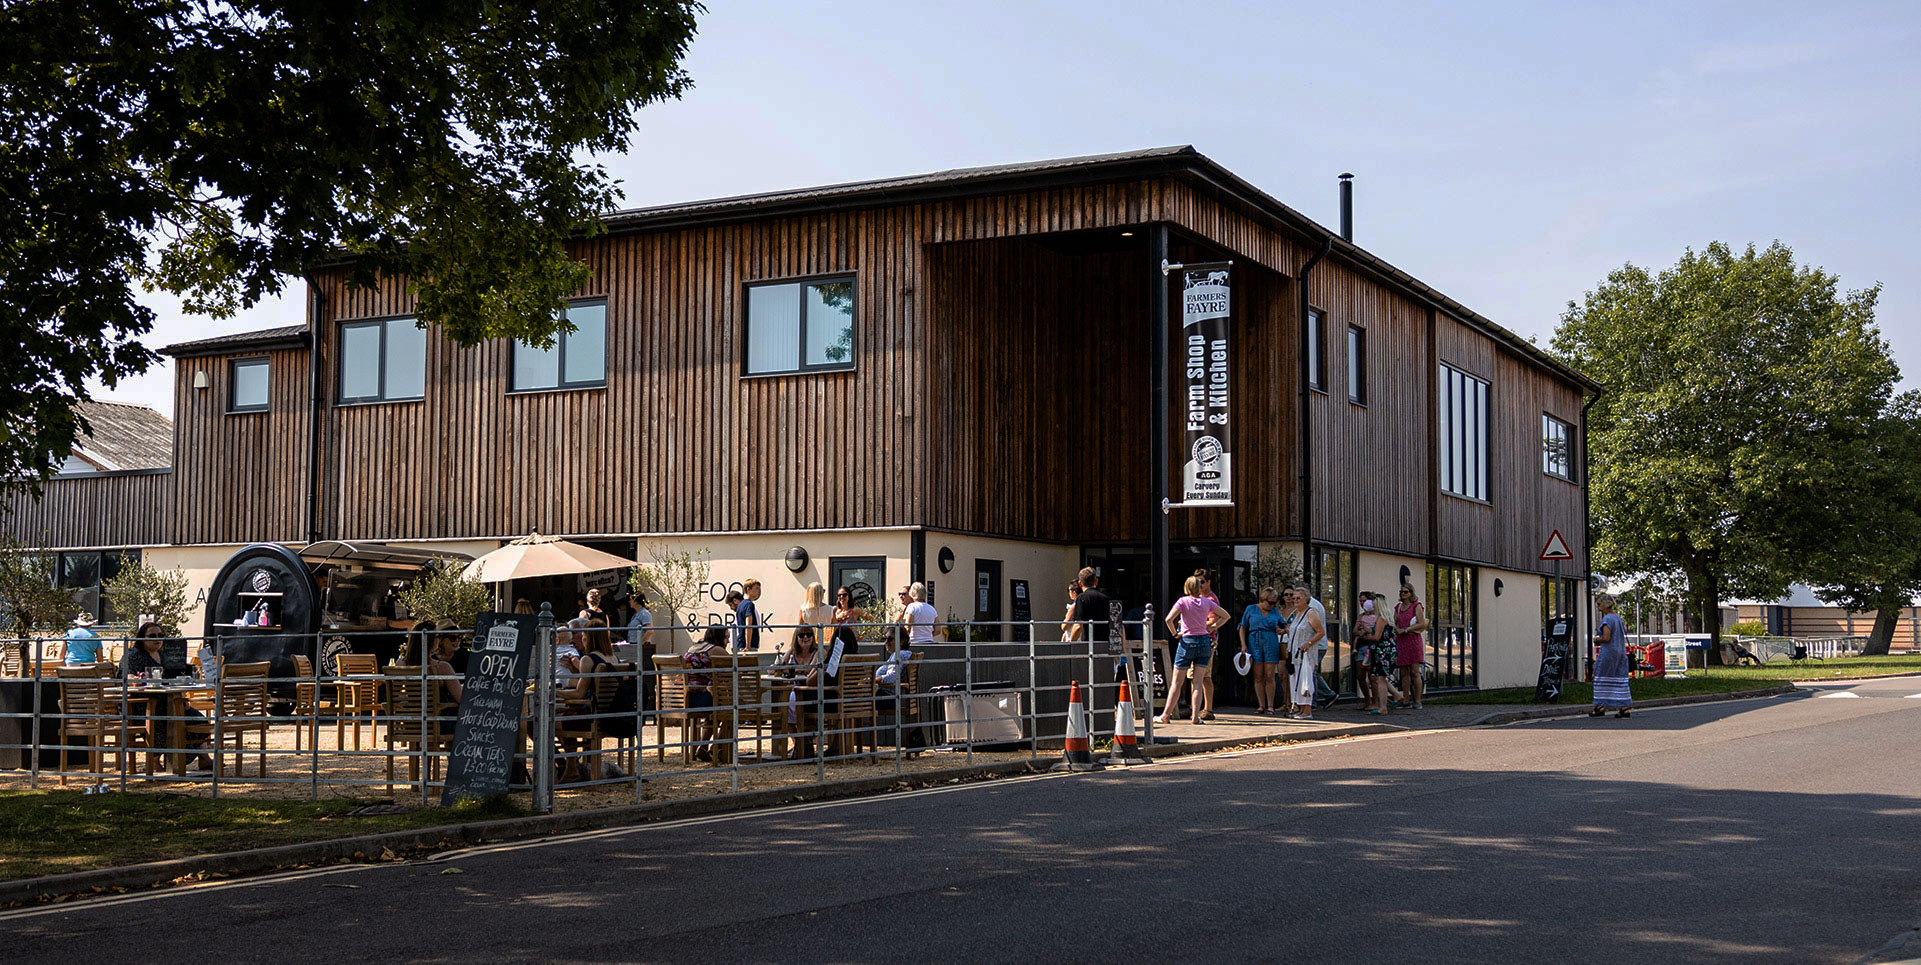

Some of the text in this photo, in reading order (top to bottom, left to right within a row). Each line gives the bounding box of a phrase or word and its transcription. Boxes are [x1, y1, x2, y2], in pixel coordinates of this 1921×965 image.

[1187, 292, 1226, 302] FARMERS
[1187, 301, 1226, 313] FAYRE
[1187, 334, 1206, 431] Farm Shop
[1209, 339, 1228, 425] & Kitchen
[1206, 491, 1229, 499] Sunday
[698, 582, 761, 602] FOO
[686, 613, 774, 633] & DRK
[489, 638, 514, 648] FAYRE
[490, 630, 516, 638] FARMERS
[480, 654, 519, 680] OPEN
[454, 741, 483, 759] CREAM
